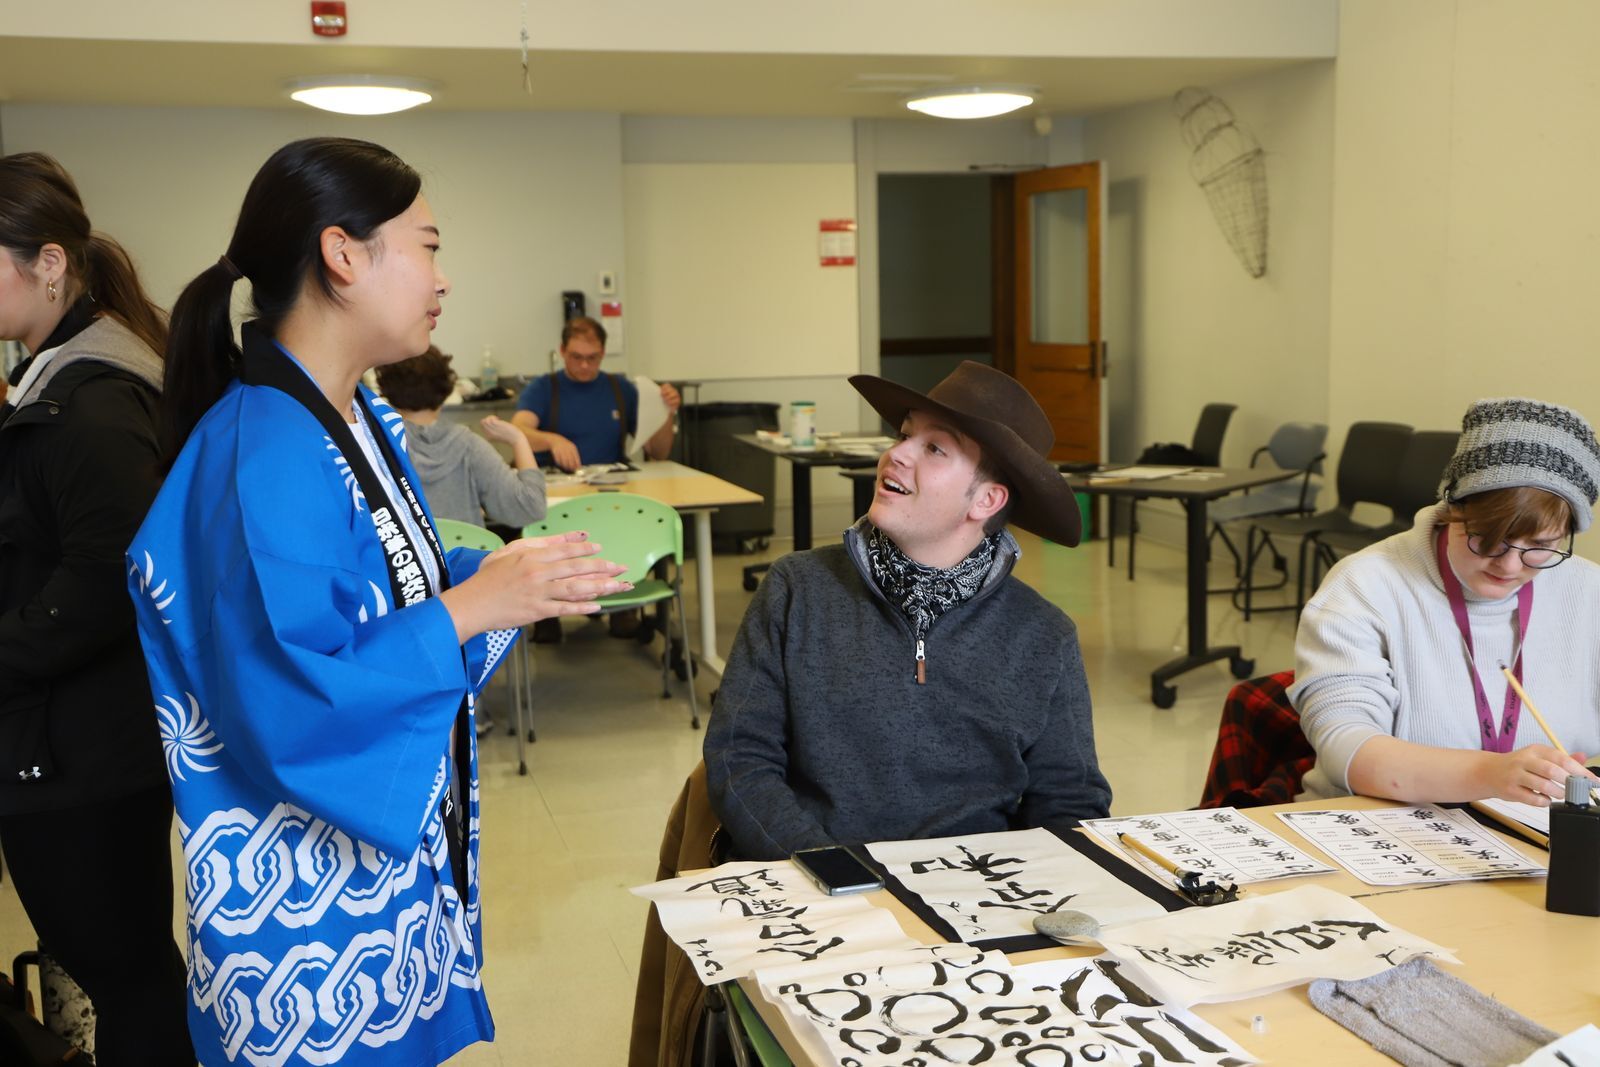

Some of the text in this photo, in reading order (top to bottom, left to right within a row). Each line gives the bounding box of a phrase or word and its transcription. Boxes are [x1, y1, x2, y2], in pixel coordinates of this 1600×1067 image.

[1364, 839, 1398, 850] 空
[1182, 857, 1215, 870] 花
[1381, 853, 1416, 865] 花
